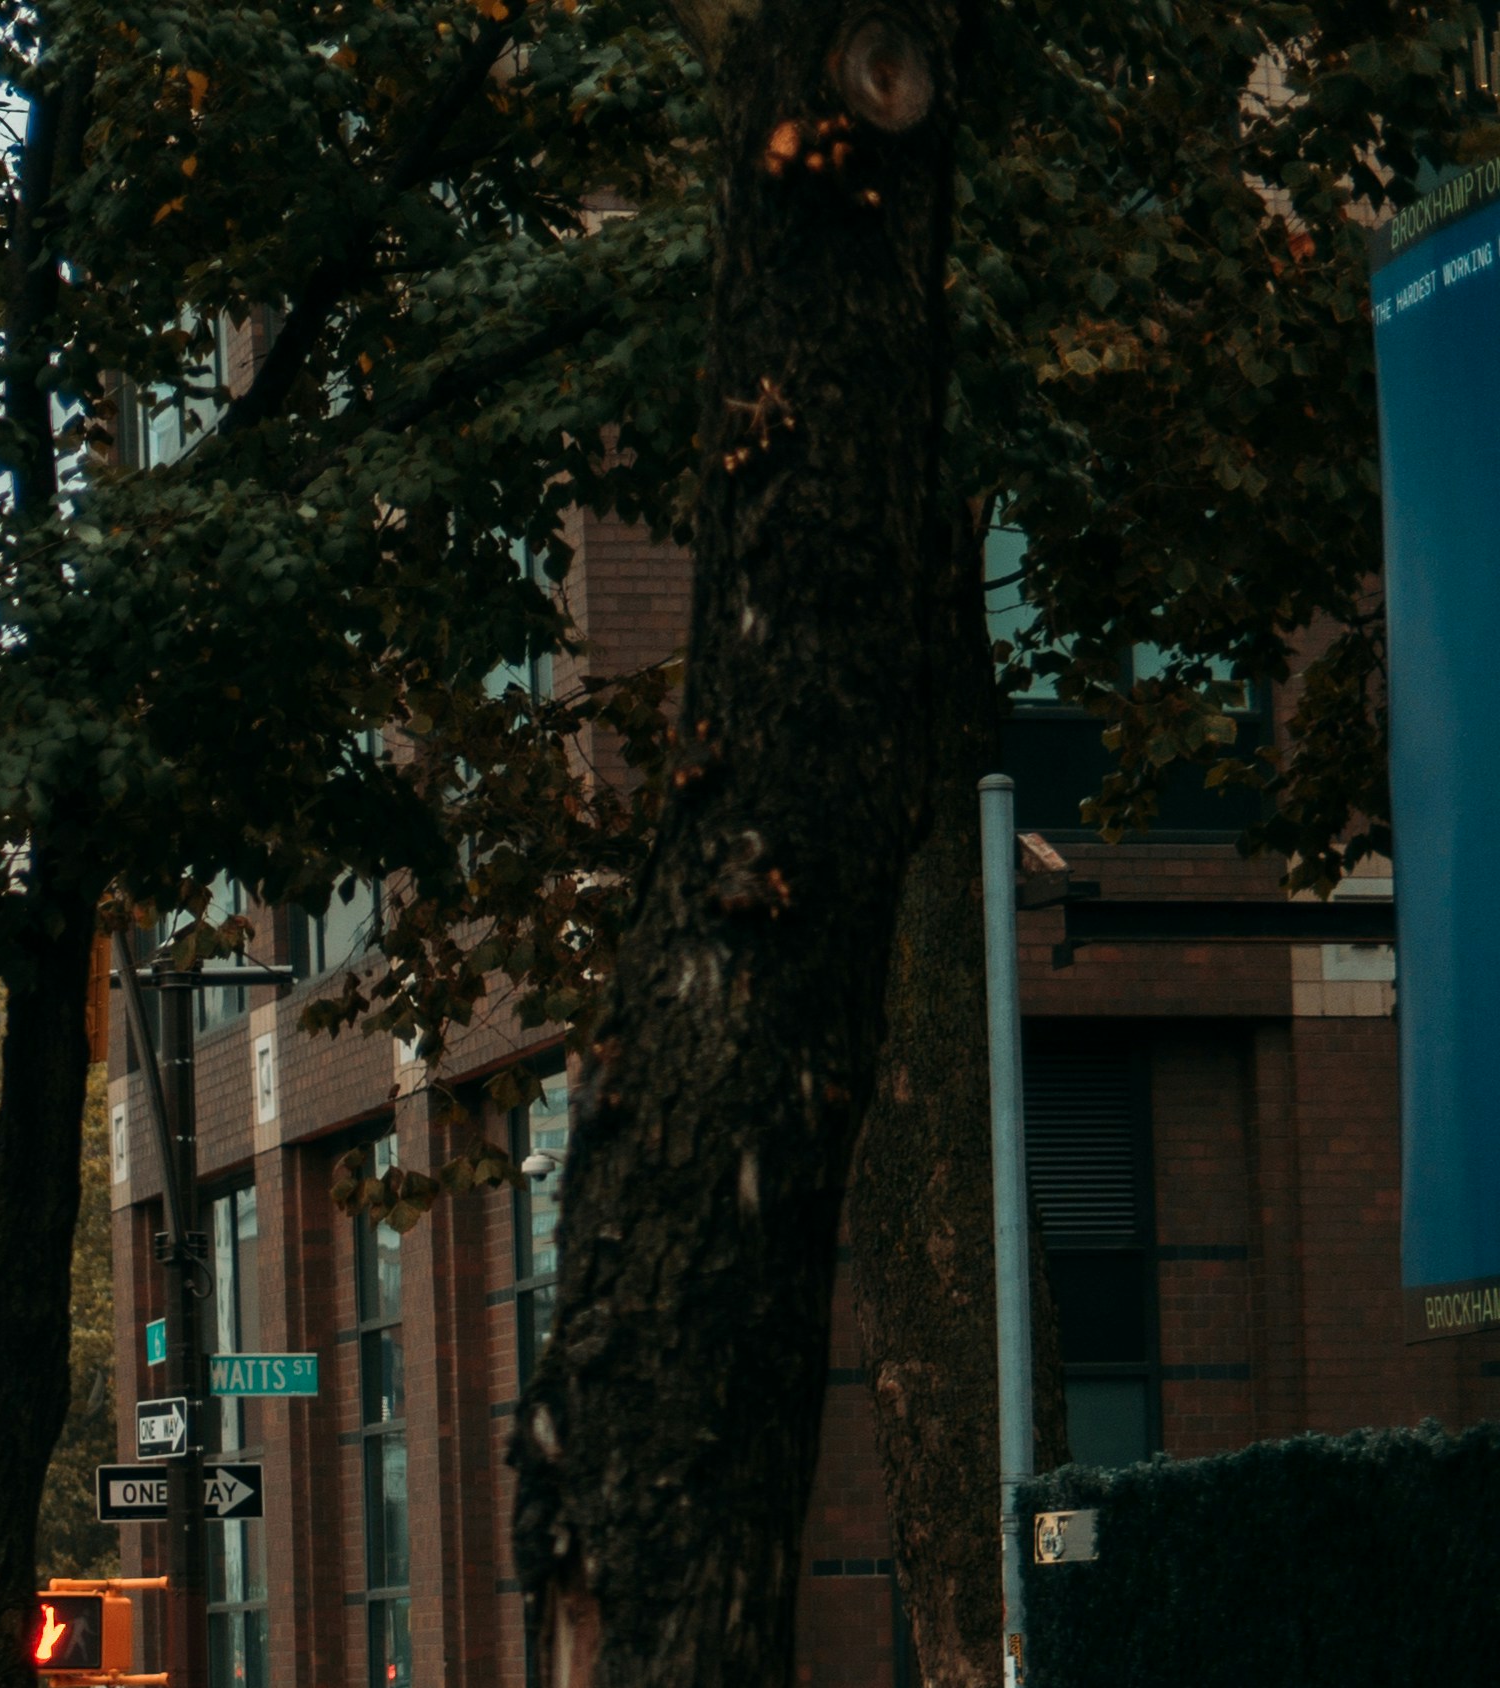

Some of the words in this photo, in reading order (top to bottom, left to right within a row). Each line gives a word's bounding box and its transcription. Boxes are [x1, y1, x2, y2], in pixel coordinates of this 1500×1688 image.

[1396, 269, 1436, 313] HARDEST
[1442, 242, 1493, 287] WORKING
[211, 1359, 286, 1390] WATTS
[293, 1359, 313, 1376] ST
[141, 1419, 155, 1441] ONE
[163, 1417, 178, 1439] WAY
[122, 1483, 168, 1504] ONE
[204, 1482, 238, 1503] AY
